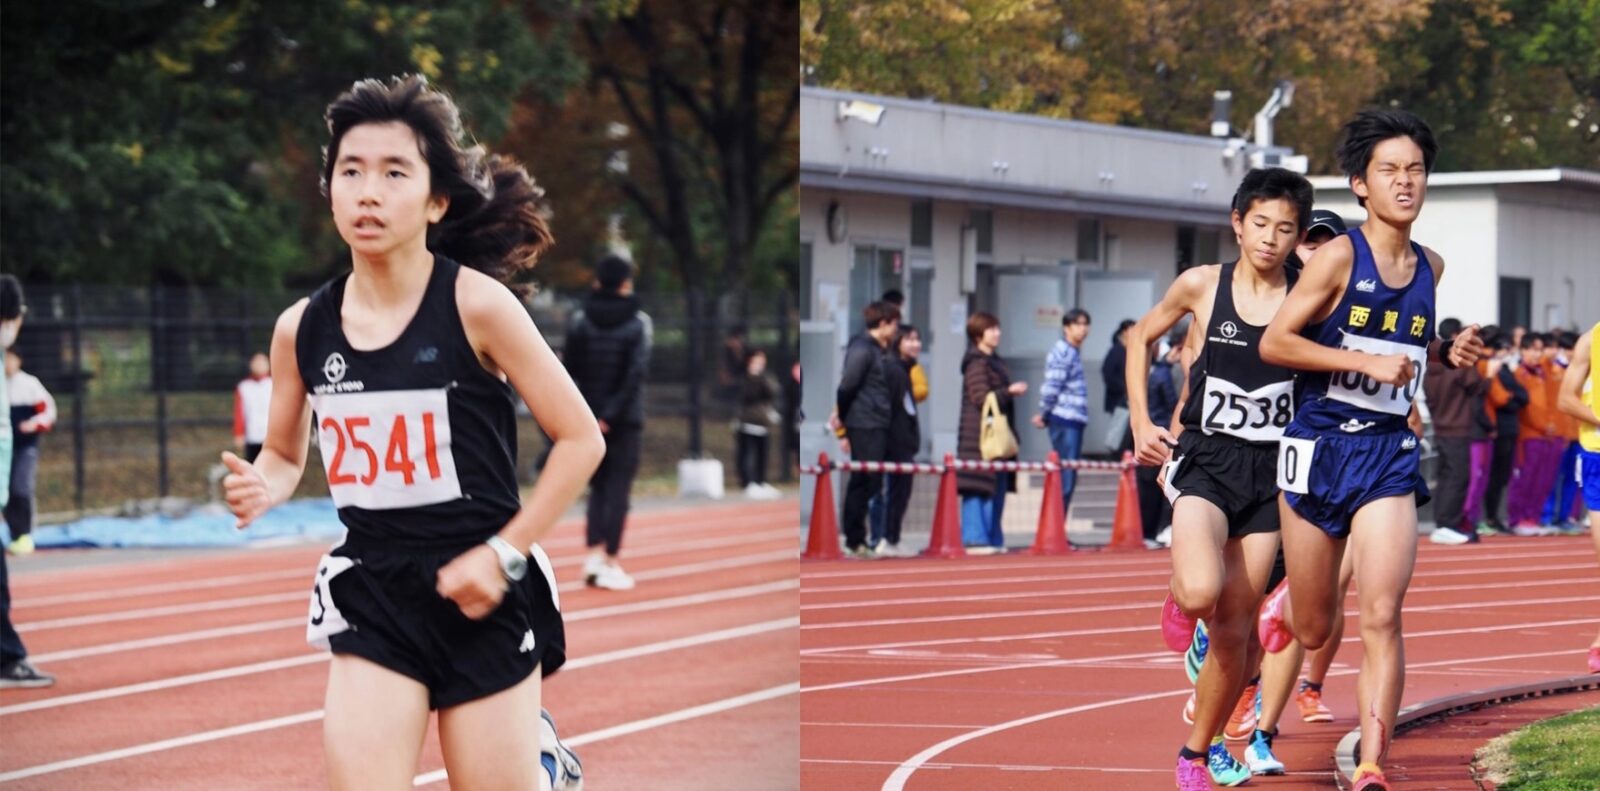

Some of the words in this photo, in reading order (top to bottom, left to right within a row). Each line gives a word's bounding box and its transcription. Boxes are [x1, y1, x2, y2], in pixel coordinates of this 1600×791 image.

[1348, 305, 1427, 338] 西賀茂
[1204, 390, 1292, 430] 2538
[321, 412, 441, 487] 2541
[1285, 445, 1298, 485] 0
